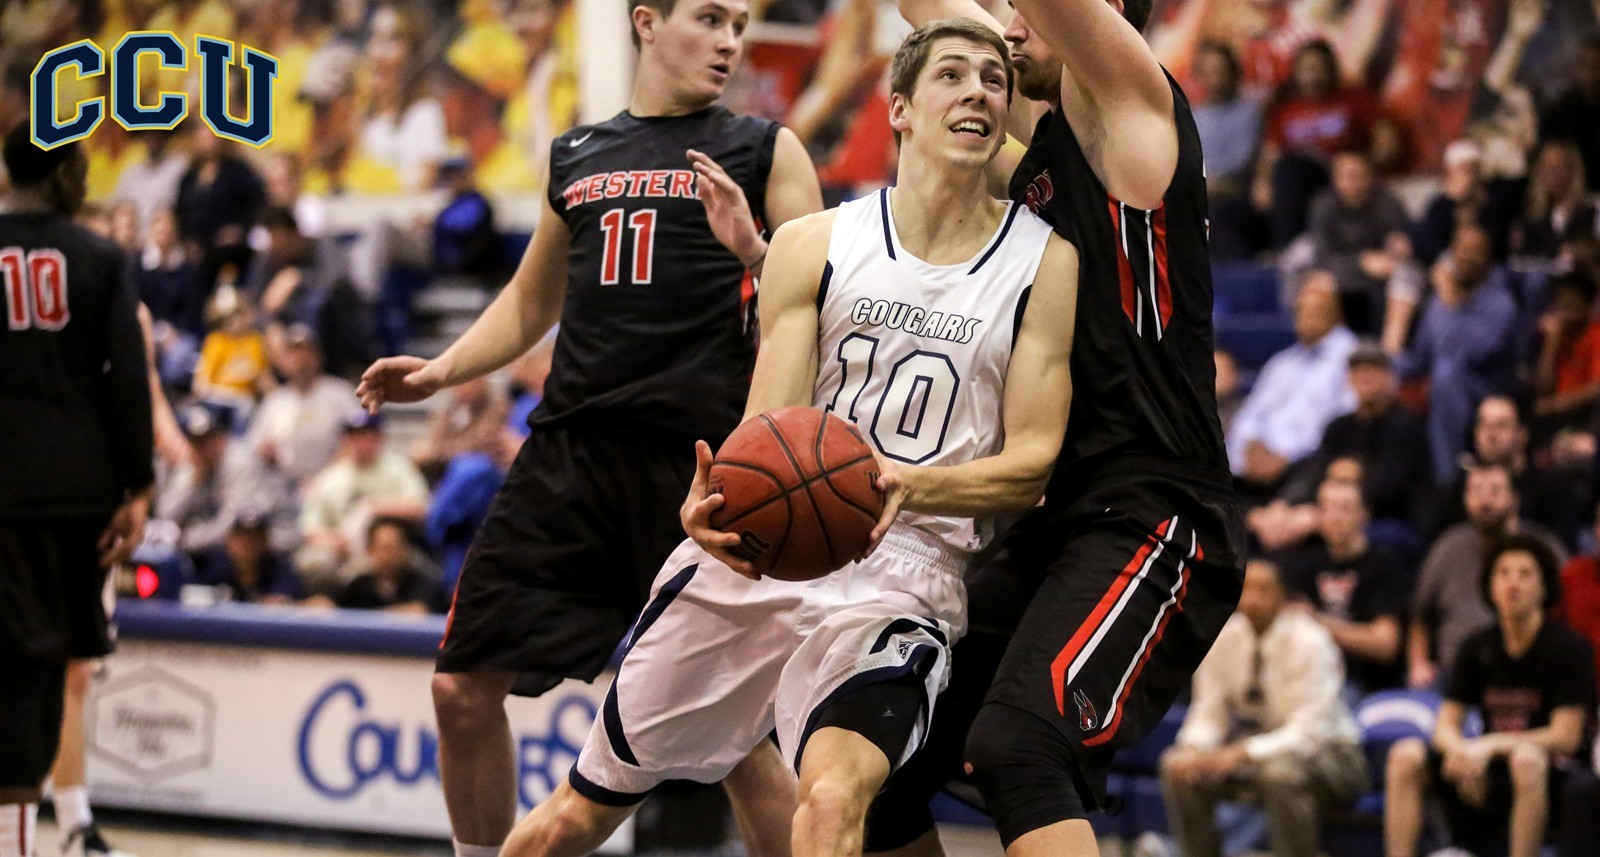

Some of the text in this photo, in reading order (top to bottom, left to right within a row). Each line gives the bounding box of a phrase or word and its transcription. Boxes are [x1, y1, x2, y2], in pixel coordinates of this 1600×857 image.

[562, 169, 703, 210] WESTER
[600, 208, 657, 286] 11
[0, 246, 71, 331] 10
[851, 297, 983, 345] COUGARS
[837, 331, 961, 466] 10
